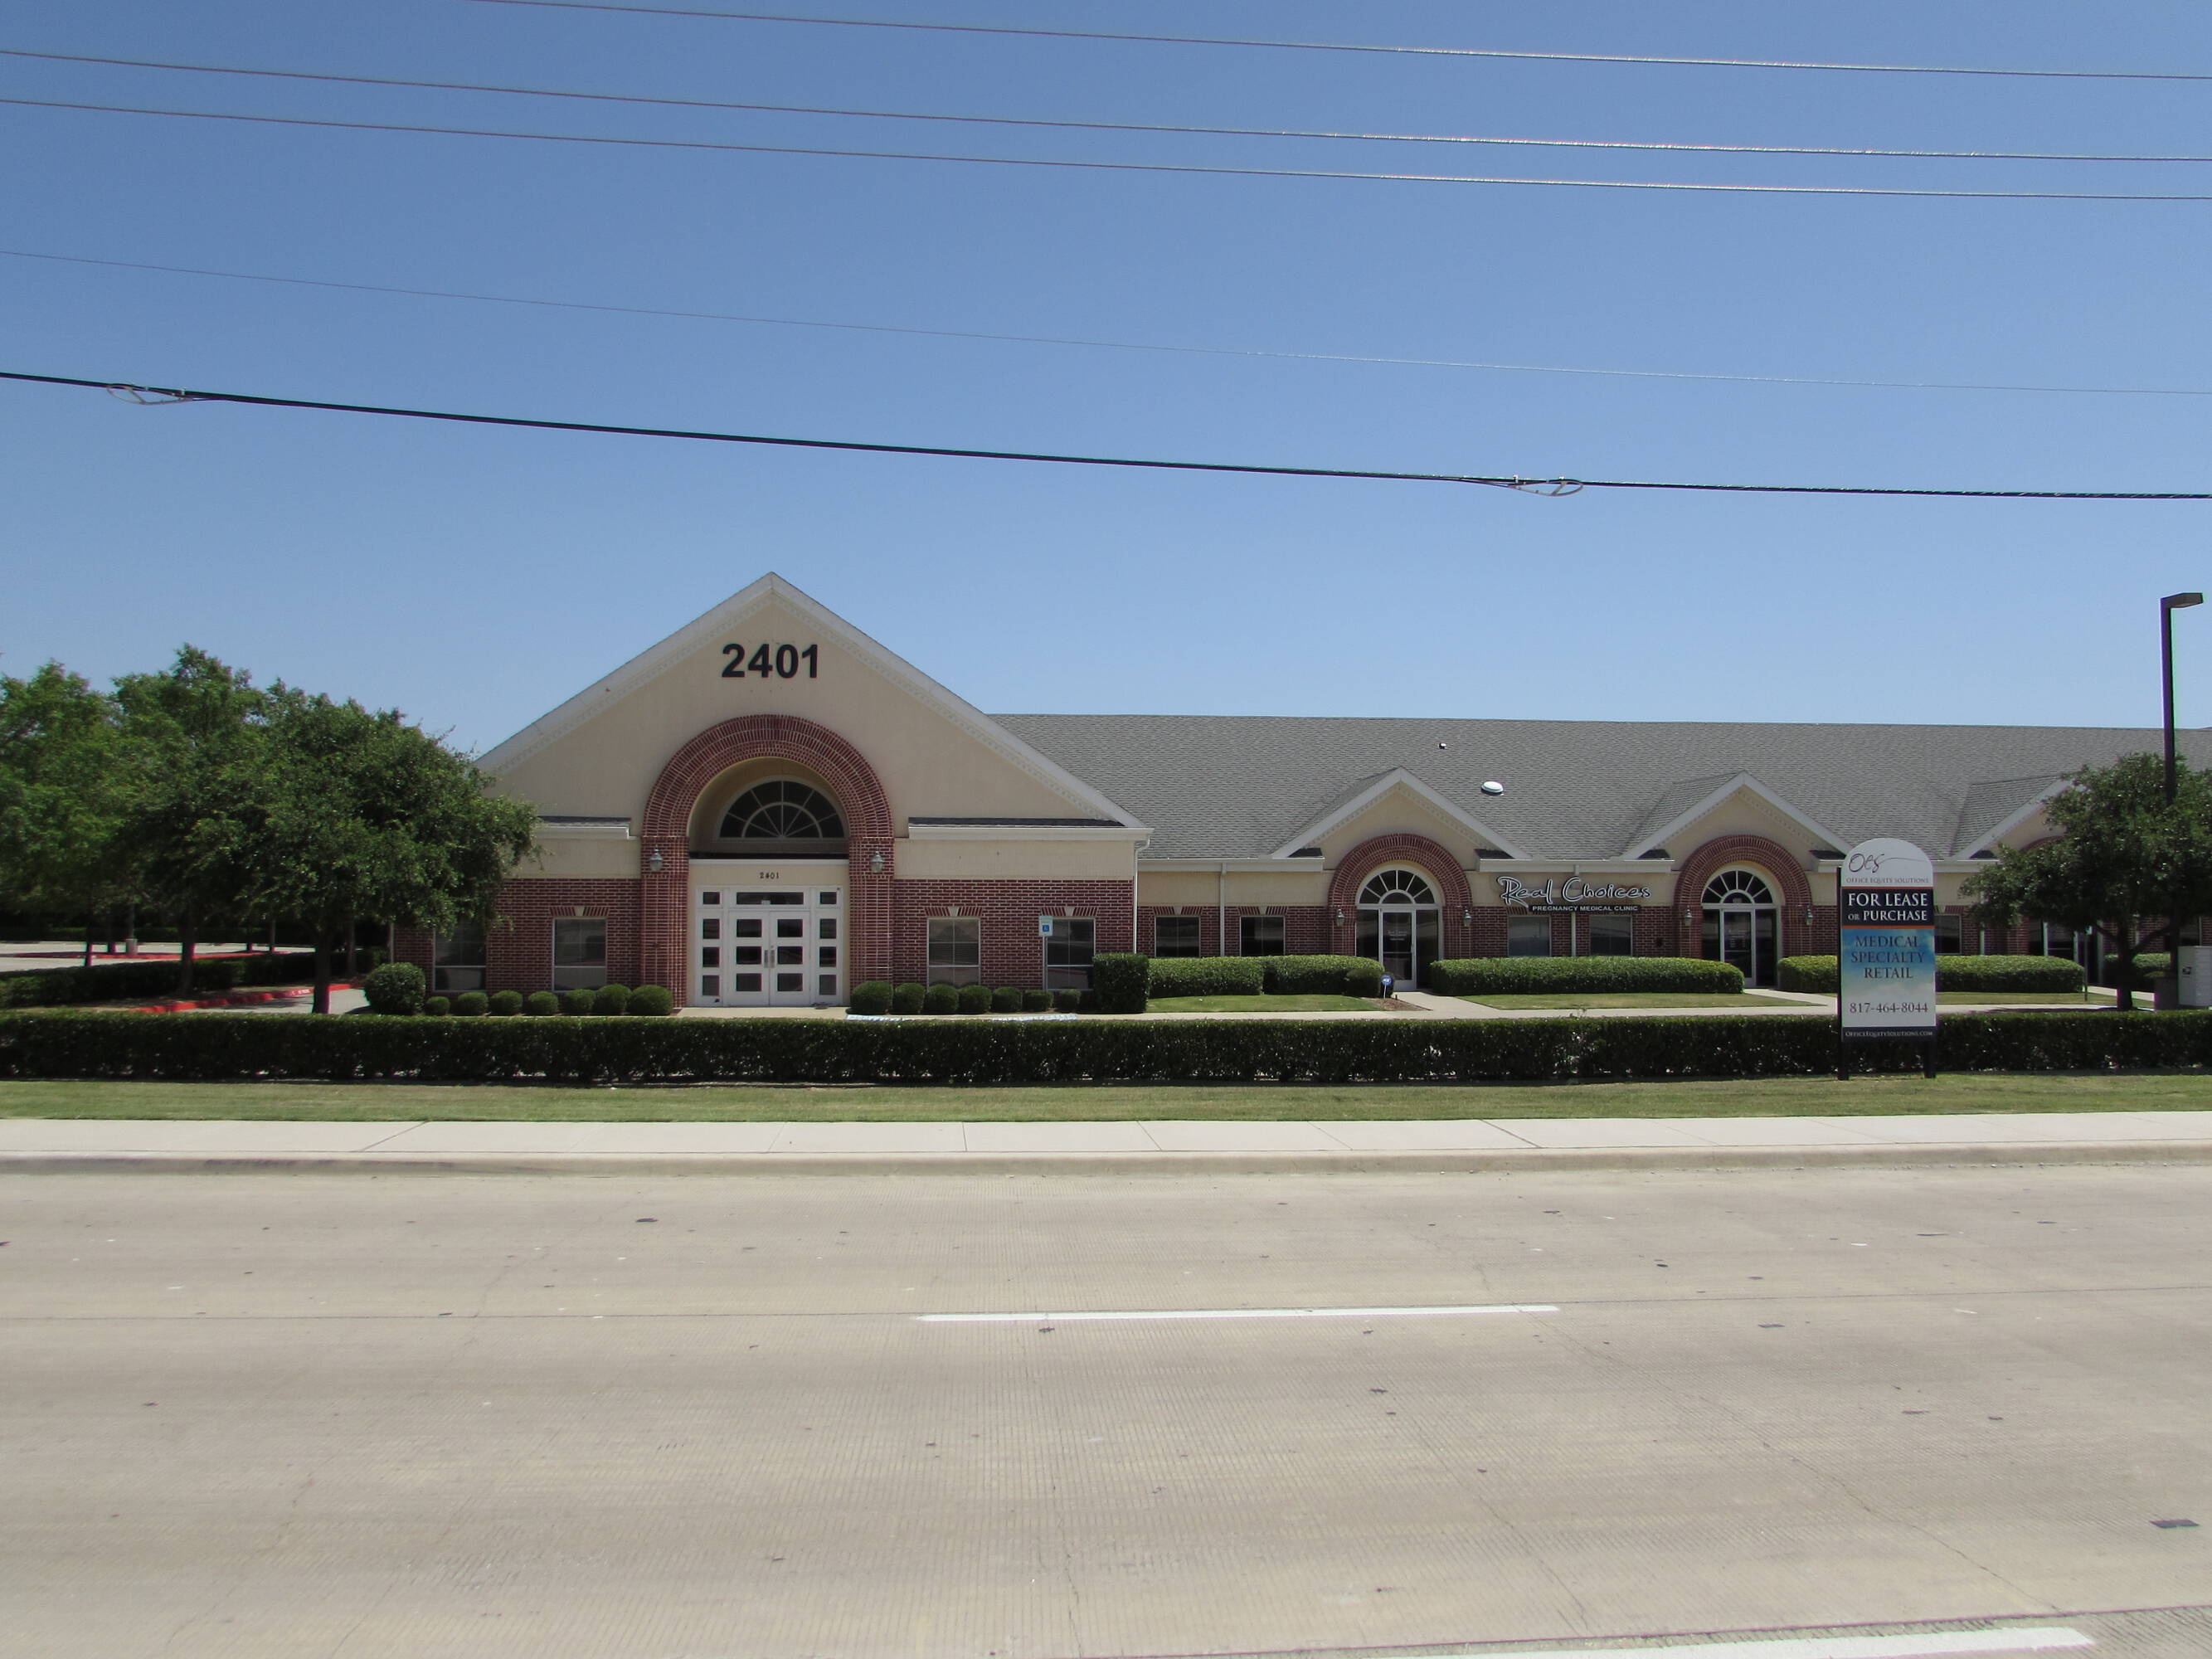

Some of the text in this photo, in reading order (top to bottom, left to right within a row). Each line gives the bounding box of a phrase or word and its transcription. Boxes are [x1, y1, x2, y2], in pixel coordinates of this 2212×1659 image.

[722, 643, 819, 679] 2401
[759, 871, 780, 879] 2401
[1497, 876, 1650, 908] Real Choices
[1848, 893, 1928, 907] FOR LEASE
[1863, 910, 1928, 921] PURCHASE
[1855, 936, 1920, 947] MEDICAL
[1850, 951, 1925, 963] SPECIALTY
[1864, 967, 1913, 979] RETAIL
[1850, 1002, 1928, 1013] 817-464-8044
